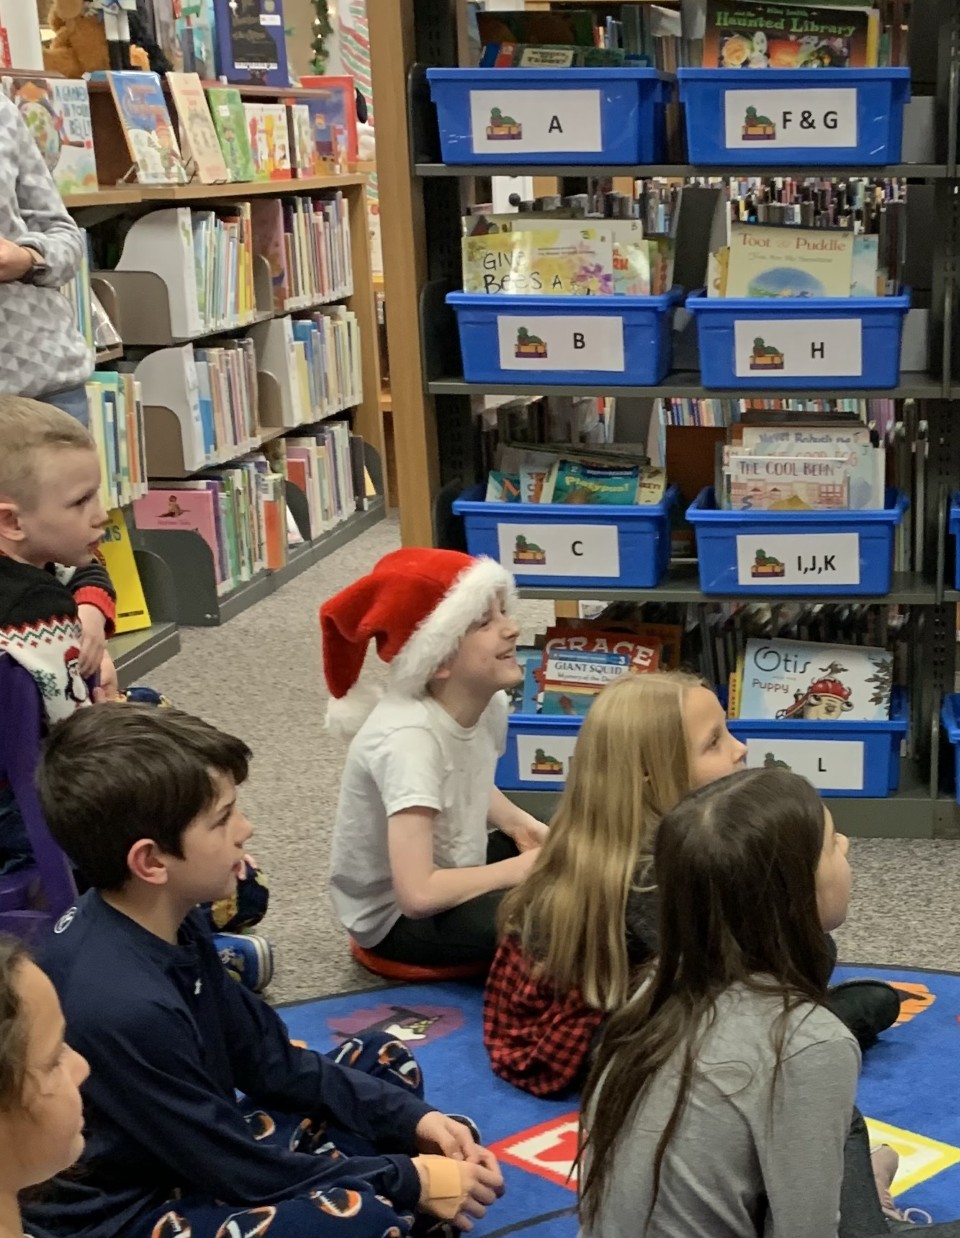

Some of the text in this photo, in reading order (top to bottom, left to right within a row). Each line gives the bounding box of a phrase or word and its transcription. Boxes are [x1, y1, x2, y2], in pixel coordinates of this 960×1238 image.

[715, 11, 855, 37] Haunted Library
[548, 115, 563, 134] A
[782, 110, 838, 130] F & G
[738, 232, 771, 248] Toot
[795, 236, 847, 251] Puddle
[573, 332, 586, 350] B
[810, 341, 825, 359] H
[765, 461, 798, 477] COOL
[571, 540, 584, 557] C
[797, 554, 836, 575] I,J,K
[554, 661, 623, 676] GIANT SQUID
[753, 646, 812, 674] Otis
[752, 677, 790, 694] Puppy
[818, 757, 827, 773] L
